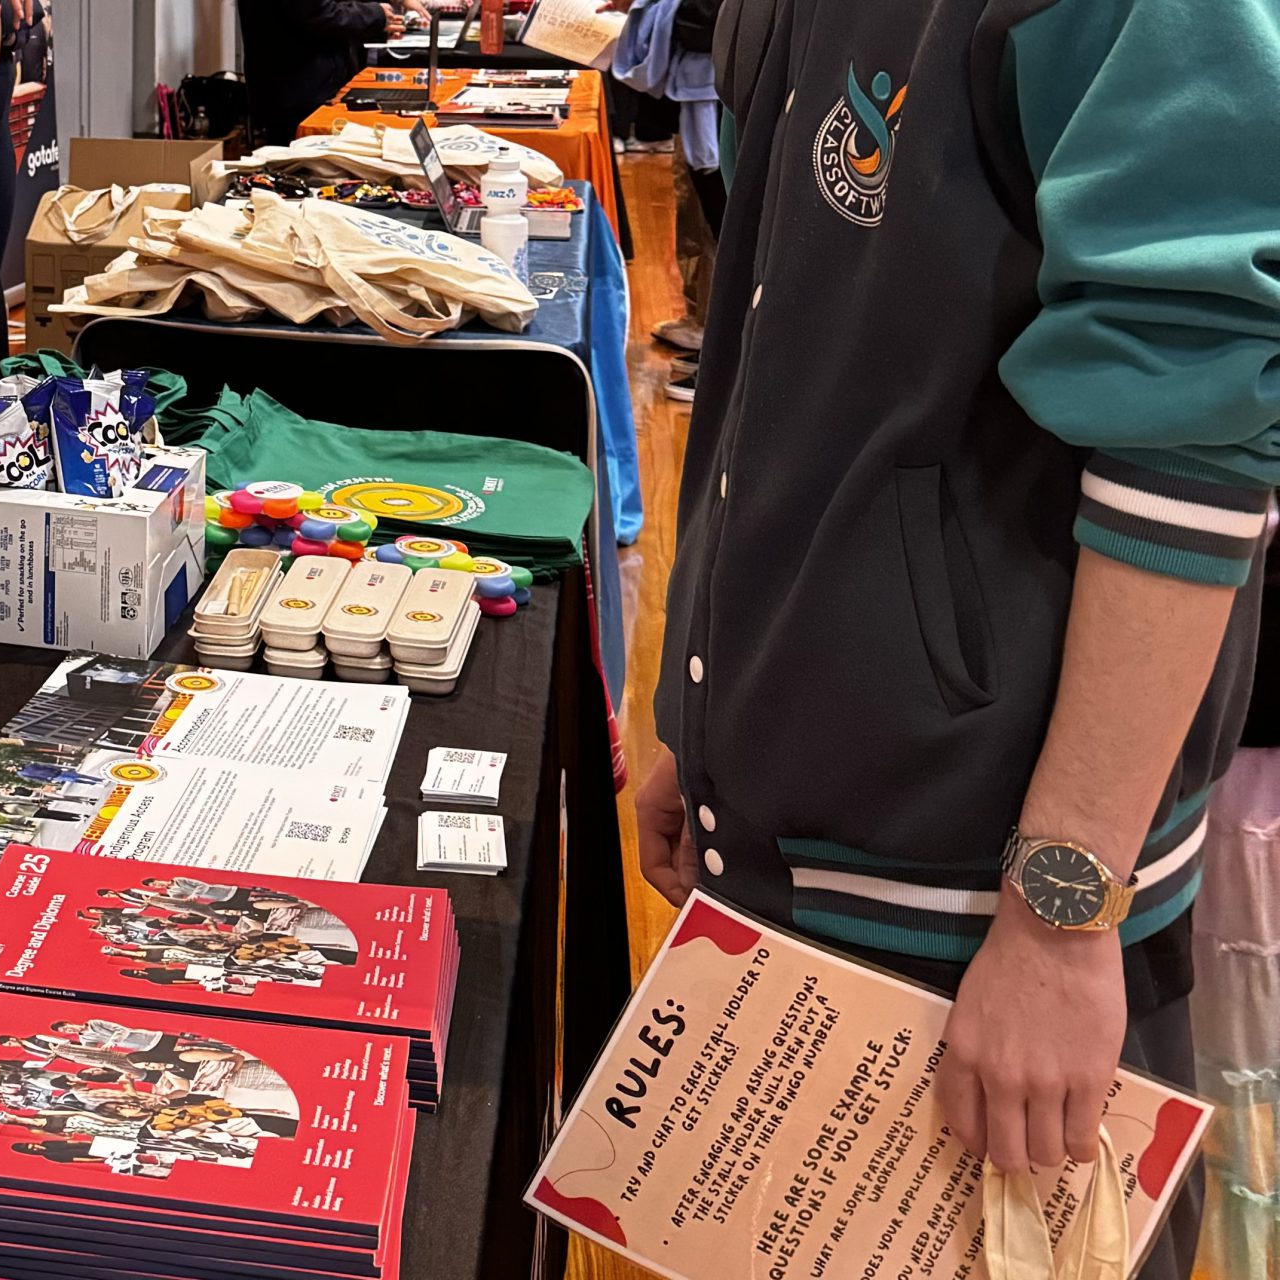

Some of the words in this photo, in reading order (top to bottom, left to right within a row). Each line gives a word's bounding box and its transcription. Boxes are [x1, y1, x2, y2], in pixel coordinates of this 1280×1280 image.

[172, 707, 214, 754] Accommodation
[130, 794, 155, 820] Access
[5, 875, 27, 898] Course
[20, 853, 51, 874] 25
[22, 877, 42, 896] Guide
[28, 931, 48, 949] and
[33, 894, 66, 930] Diploma
[5, 948, 38, 978] Degree
[605, 998, 686, 1129] RULES:
[620, 1176, 642, 1204] TRY
[636, 1150, 656, 1177] AND
[652, 1114, 676, 1150] CHAT
[670, 1096, 687, 1116] TO
[680, 1060, 708, 1096] EACH
[700, 1022, 728, 1062] STALL
[722, 968, 761, 1020] HOLDER
[752, 947, 770, 968] TO
[670, 1186, 700, 1228] AFTER
[693, 1122, 736, 1185] ENGAGING
[730, 1095, 750, 1124] AND
[745, 1048, 777, 1096] ASKING
[772, 974, 818, 1048] QUESTIONS
[681, 1106, 700, 1134] GET
[700, 1040, 740, 1107] STICKERS!
[692, 1194, 714, 1223] THE
[708, 1156, 737, 1198] STALL
[731, 1106, 767, 1156] HOLDER
[761, 1074, 784, 1107] WILL
[778, 1040, 806, 1073] THEN
[798, 1006, 820, 1038] PUT
[815, 993, 830, 1007] A
[713, 1172, 750, 1224] STICKER
[742, 1152, 762, 1172] ON
[754, 1113, 784, 1150] THEIR
[776, 1070, 806, 1112] BINGO
[803, 1006, 840, 1070] NUMBER!
[756, 1210, 790, 1256] HERE
[783, 1172, 810, 1208] ARE
[802, 1123, 838, 1172] SOME
[829, 1040, 884, 1122] EXAMPLE
[769, 1188, 827, 1280] QUESTIONS
[818, 1165, 837, 1186] IF
[831, 1128, 860, 1163] YOU
[853, 1093, 881, 1125] GET
[874, 1027, 913, 1091] STUCK:
[810, 1242, 834, 1279] WHAT
[829, 1216, 848, 1243] ARE
[843, 1181, 867, 1217] SOME
[862, 1120, 905, 1182] PATHWAYS
[899, 1075, 931, 1119] WTIHIN
[924, 1038, 949, 1074] YOUR
[868, 1125, 919, 1203] WROKPLACE?
[878, 1217, 904, 1251] YOUR
[897, 1137, 947, 1216] APPLICATION
[910, 1230, 931, 1265] NEED
[926, 1203, 945, 1230] ANY
[919, 1198, 966, 1277] SUCCESSFUL
[960, 1183, 976, 1198] IN
